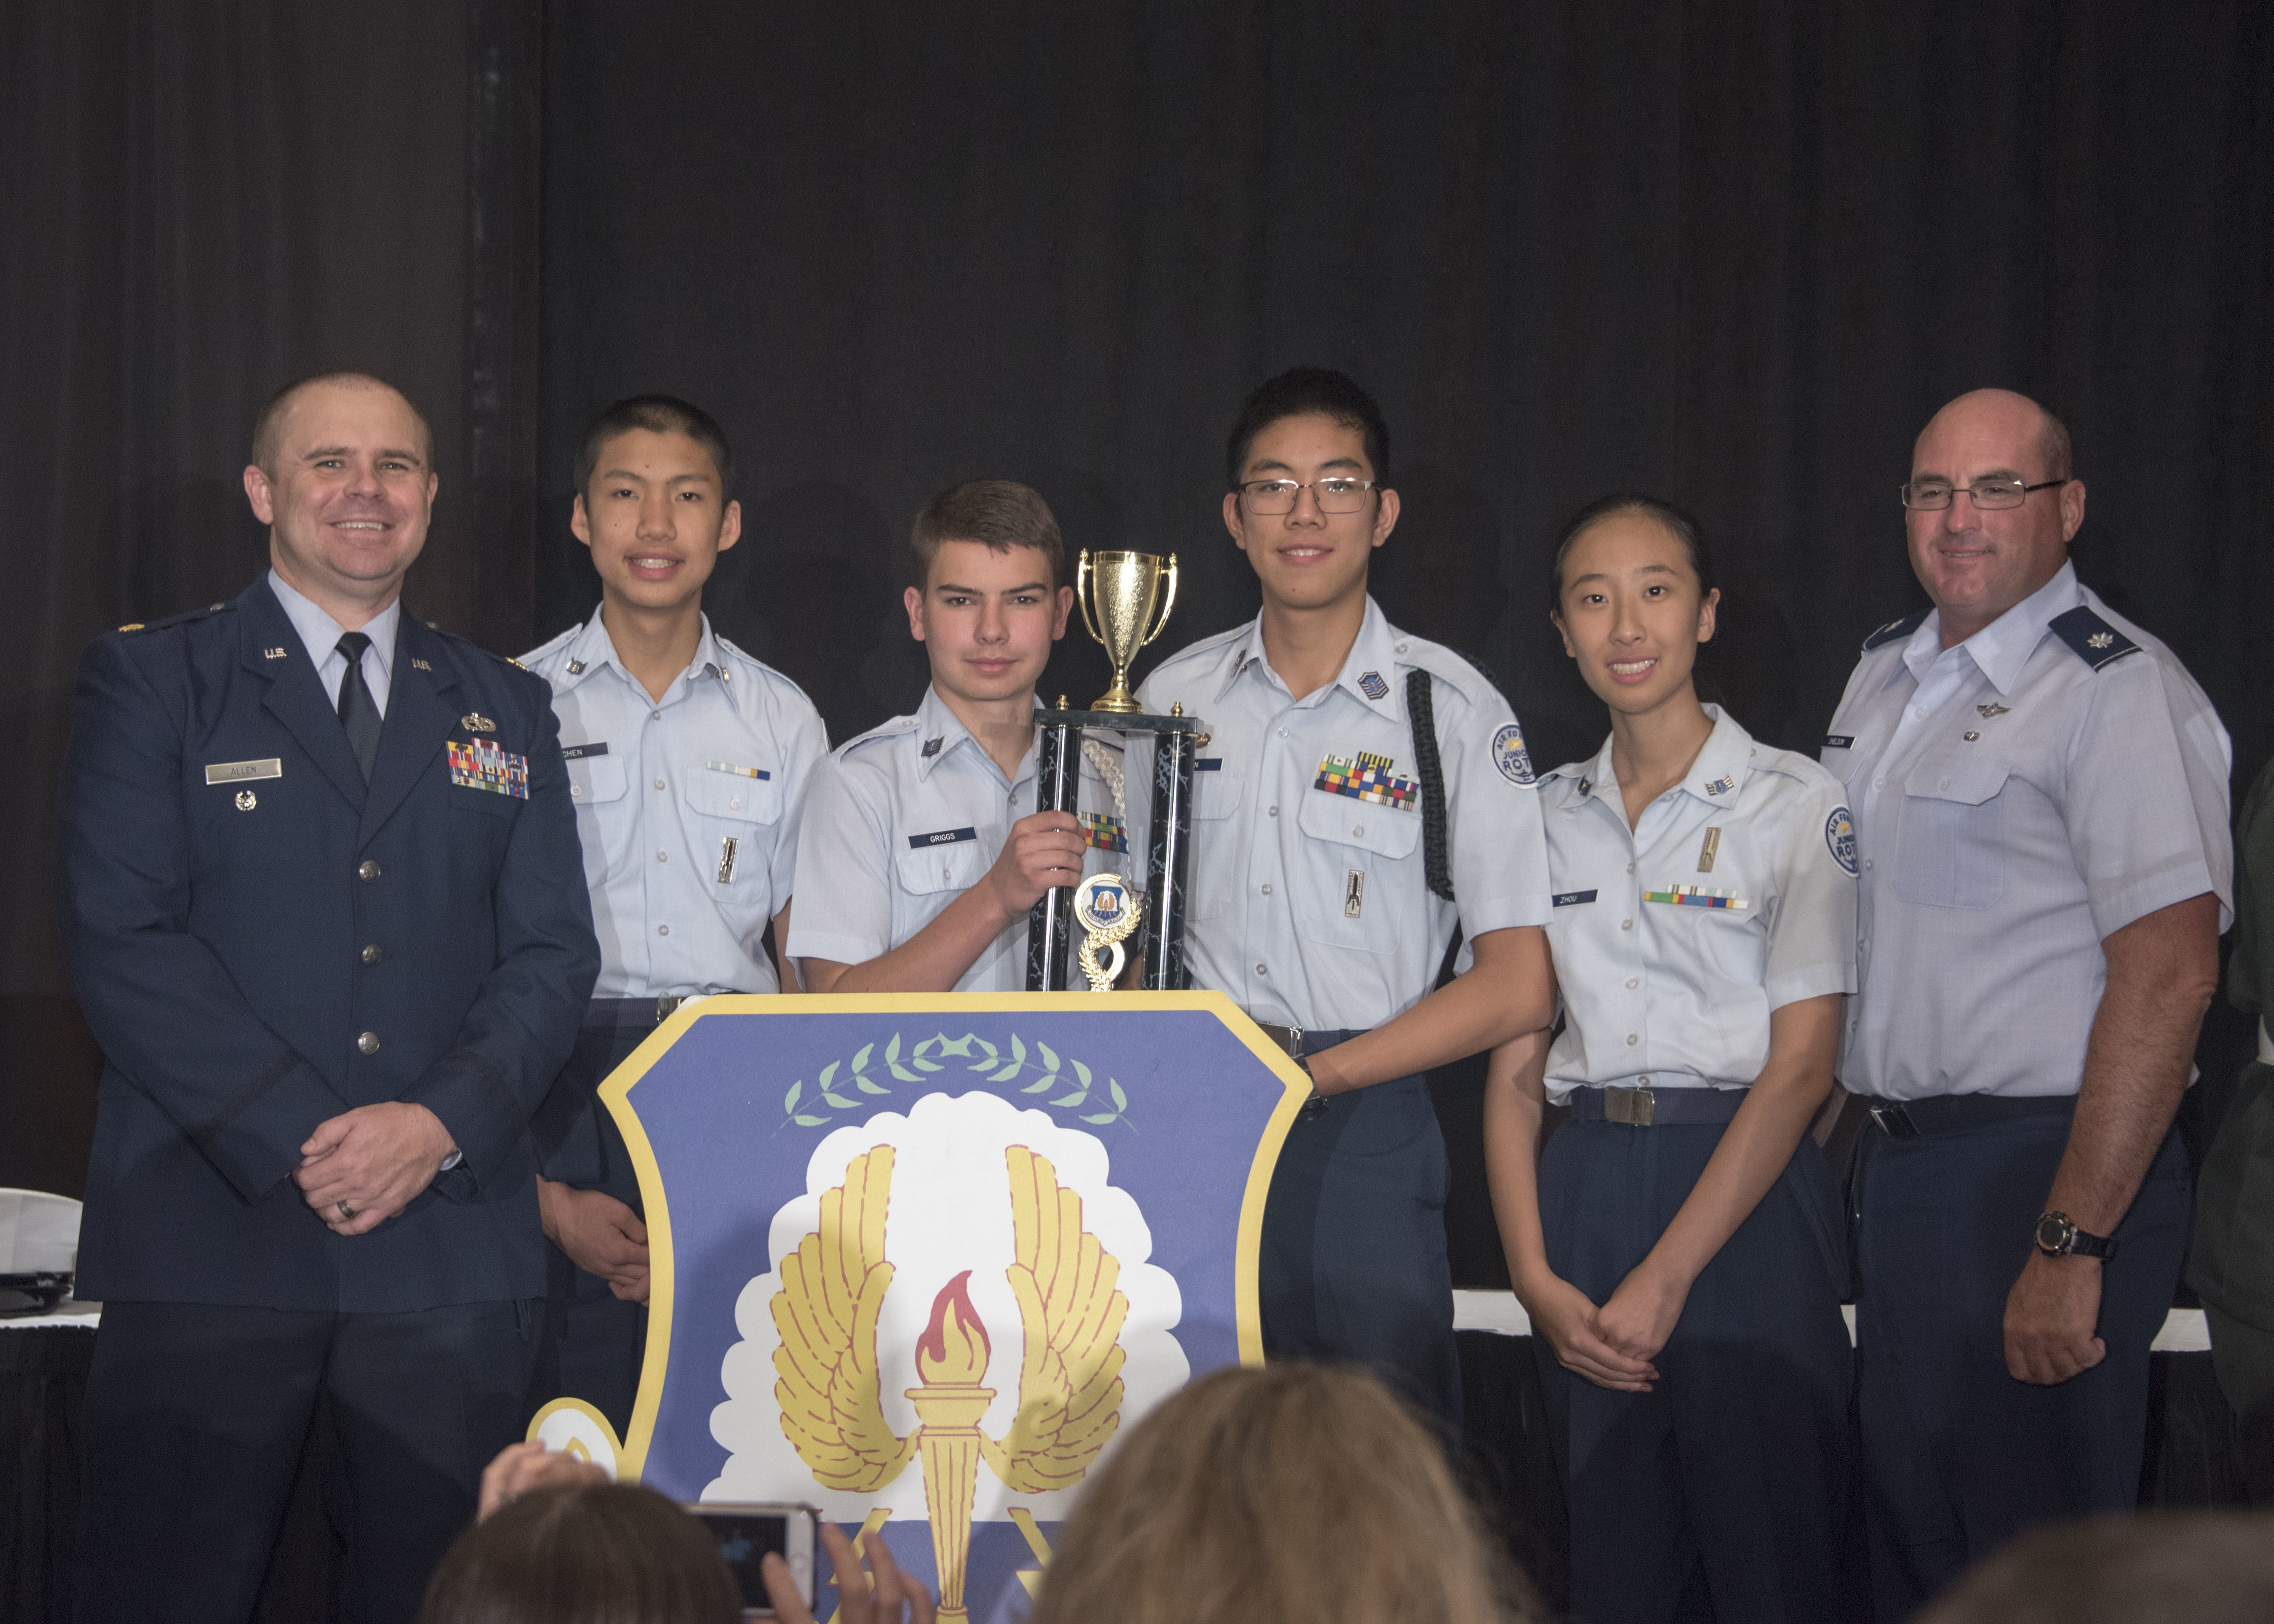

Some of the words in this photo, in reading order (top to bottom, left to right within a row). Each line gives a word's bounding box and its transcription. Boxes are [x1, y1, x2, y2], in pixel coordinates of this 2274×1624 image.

[1497, 735, 1507, 750] AIR
[563, 749, 582, 758] CHEN
[1504, 749, 1527, 759] JUNIO
[1503, 757, 1530, 771] ROT
[231, 766, 256, 776] ALLEN
[1830, 818, 1839, 836] AIR
[930, 832, 955, 843] GRIGGS
[1560, 895, 1577, 904] ZHOU
